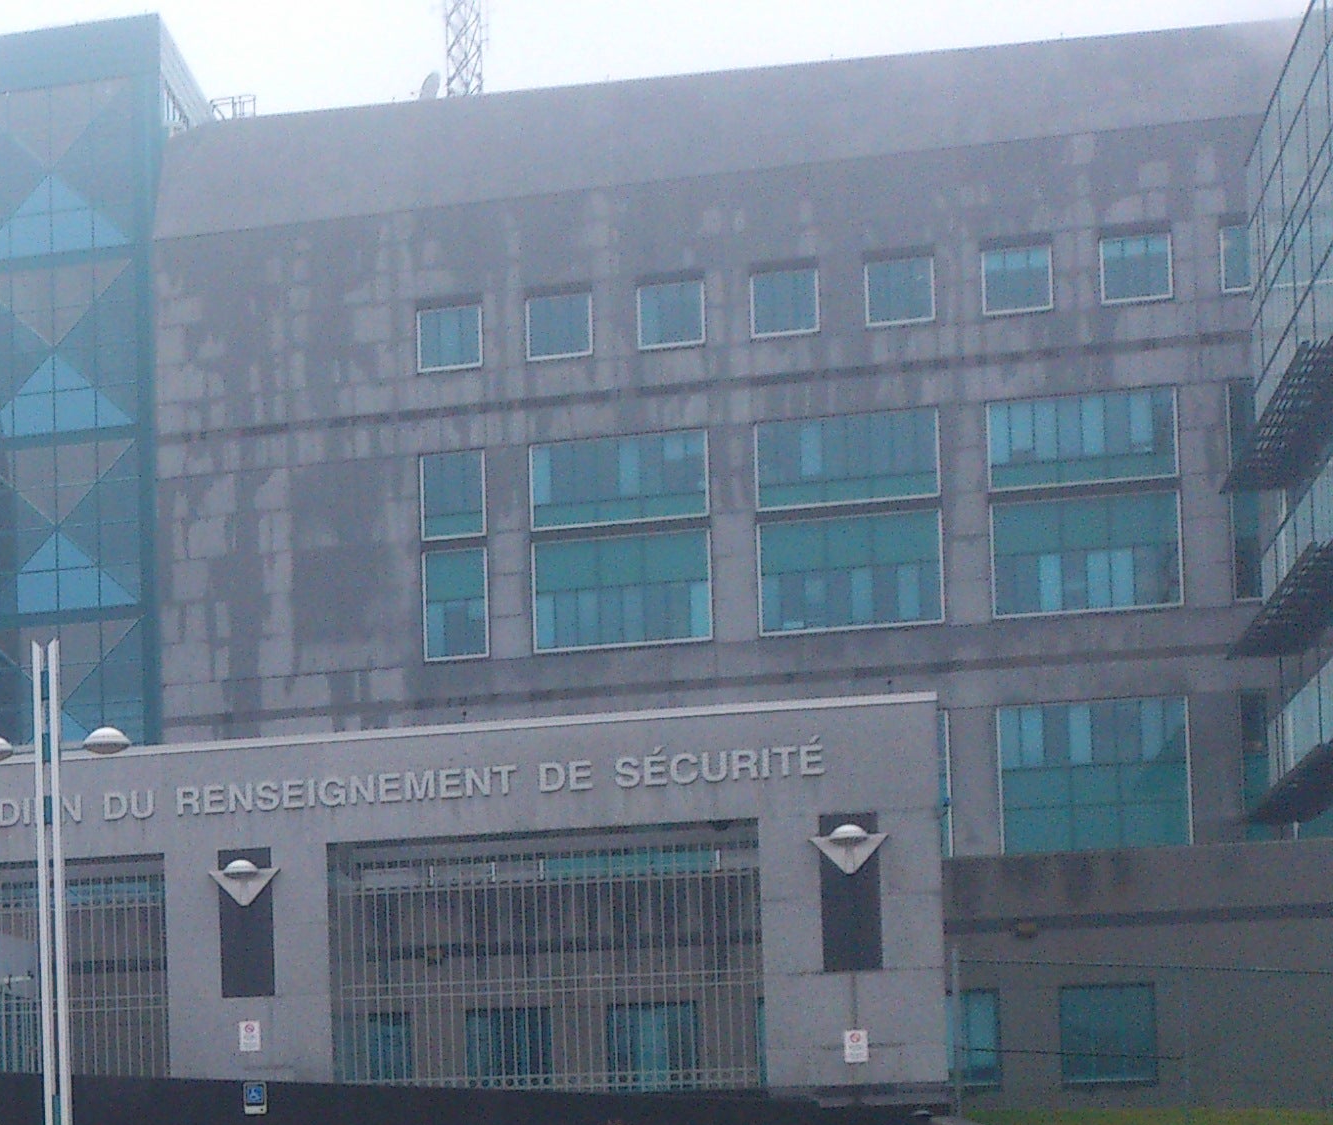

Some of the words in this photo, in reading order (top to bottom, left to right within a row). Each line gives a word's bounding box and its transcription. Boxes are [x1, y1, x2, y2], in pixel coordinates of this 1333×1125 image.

[102, 789, 156, 822] DU
[175, 763, 518, 818] RENSEIGNEMENT
[538, 758, 593, 794] DE
[613, 735, 827, 791] SÉCURITÉ
